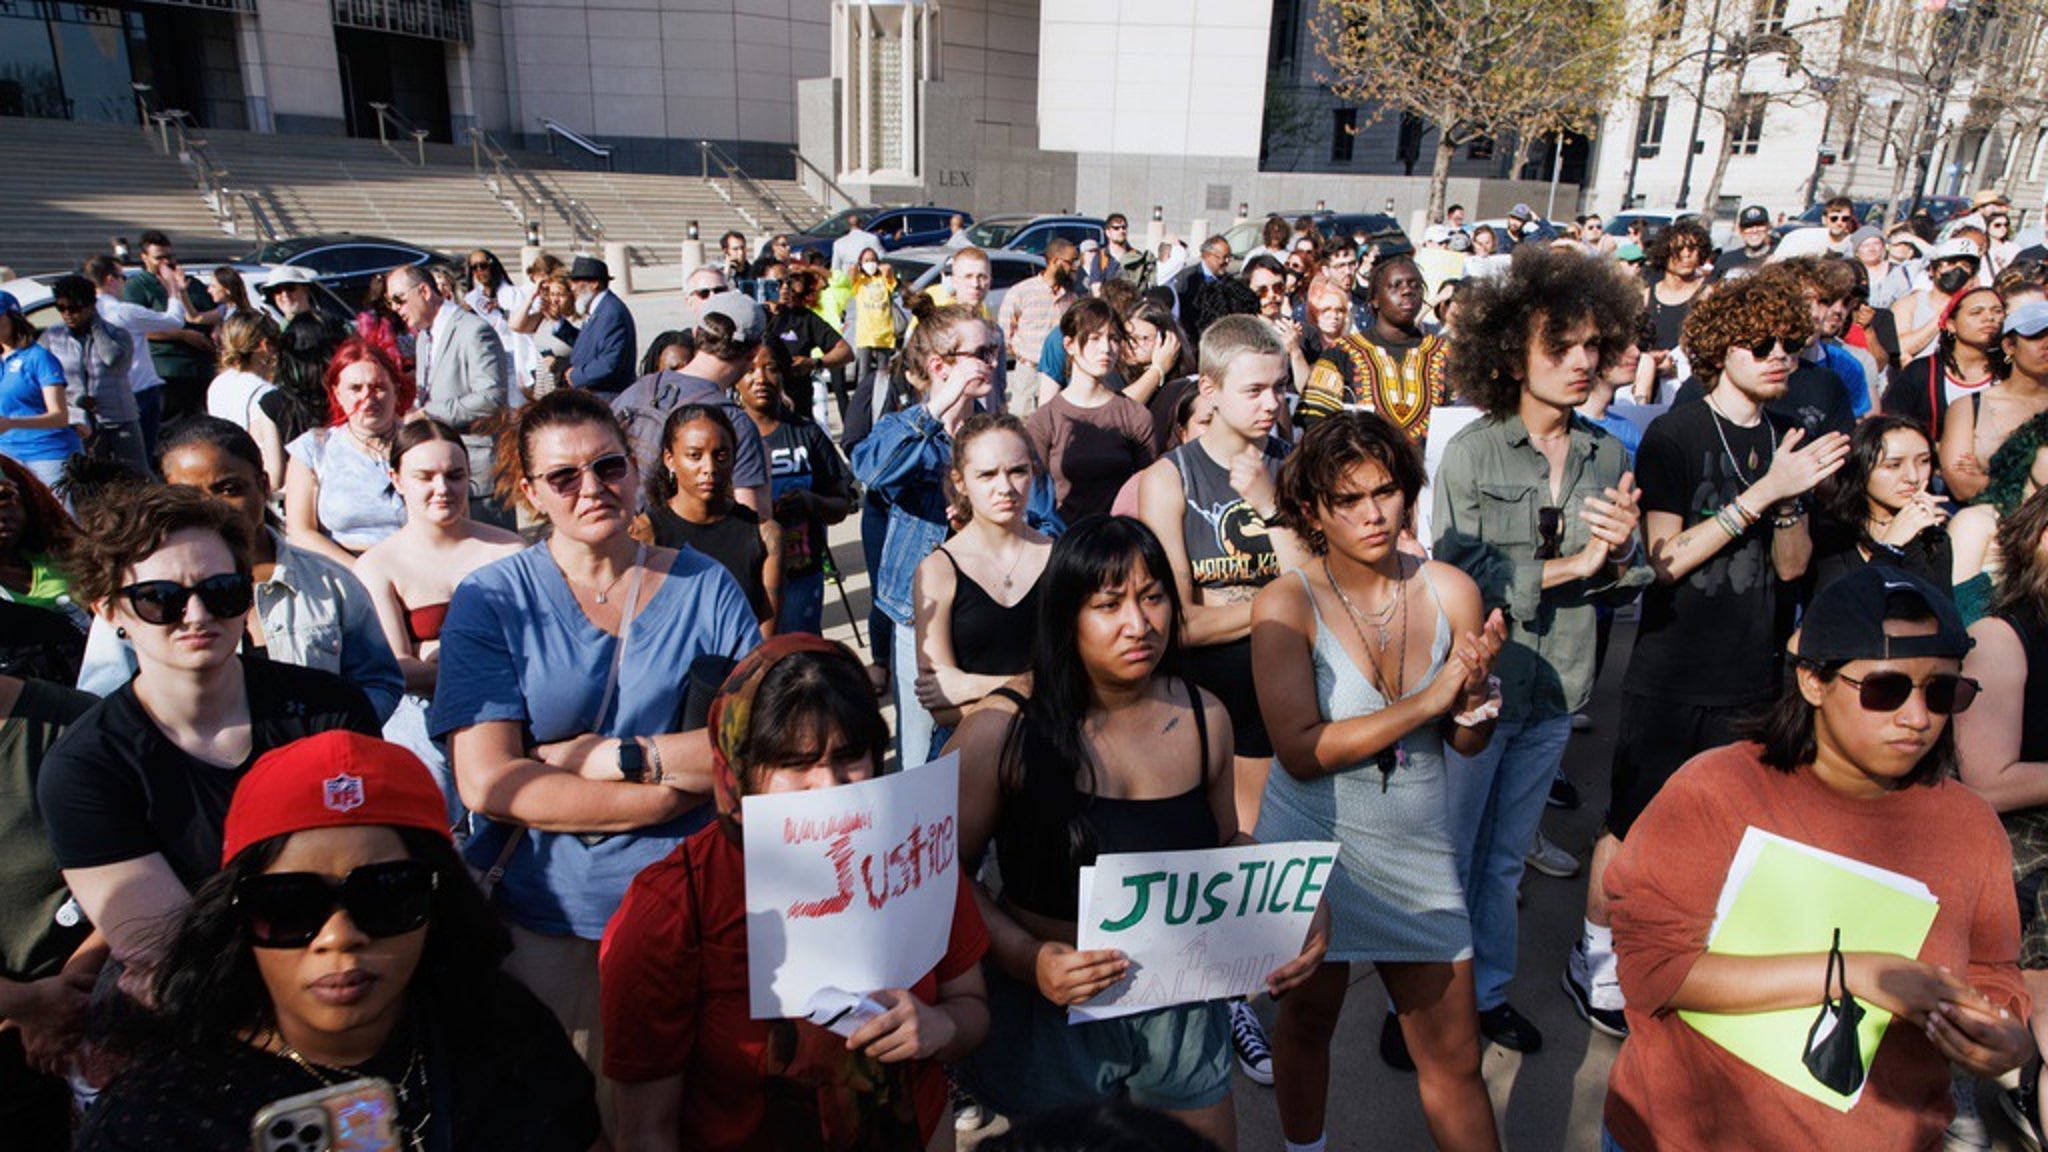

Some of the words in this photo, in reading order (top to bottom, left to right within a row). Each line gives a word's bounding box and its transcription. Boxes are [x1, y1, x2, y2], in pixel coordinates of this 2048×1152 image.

[939, 169, 971, 187] LEX
[1192, 556, 1257, 581] MORTAL
[1099, 855, 1333, 933] JUSTICE
